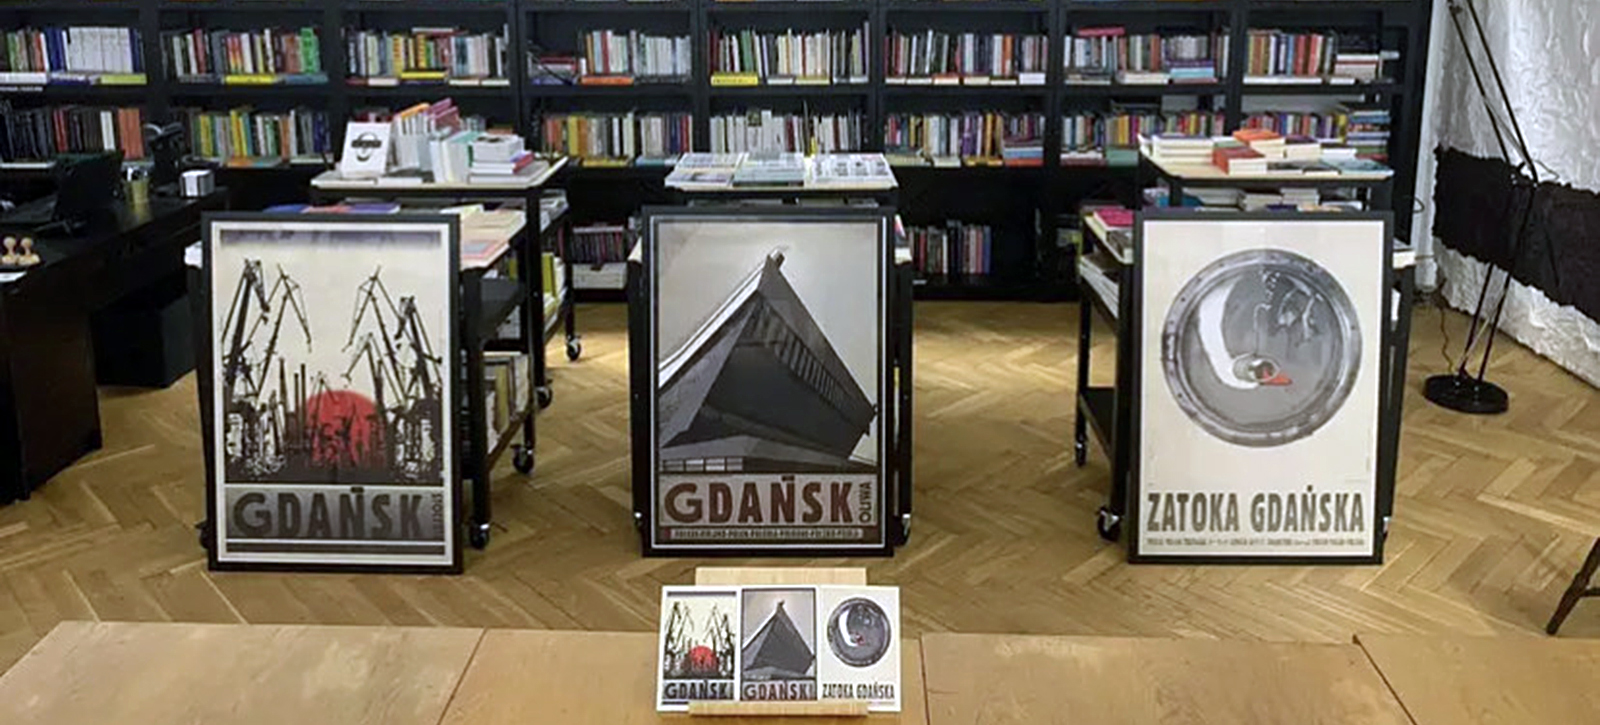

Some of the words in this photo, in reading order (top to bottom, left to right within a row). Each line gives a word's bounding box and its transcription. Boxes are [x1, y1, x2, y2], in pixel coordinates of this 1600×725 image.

[233, 486, 423, 538] GDAŃSK
[664, 475, 853, 524] GDAŃSK
[1147, 492, 1240, 532] ZATOKA
[1251, 484, 1365, 532] GDAŃSKA
[664, 679, 728, 699] GDAŃSK
[744, 679, 808, 699] GDAŃSK
[822, 683, 854, 699] ZATOKA
